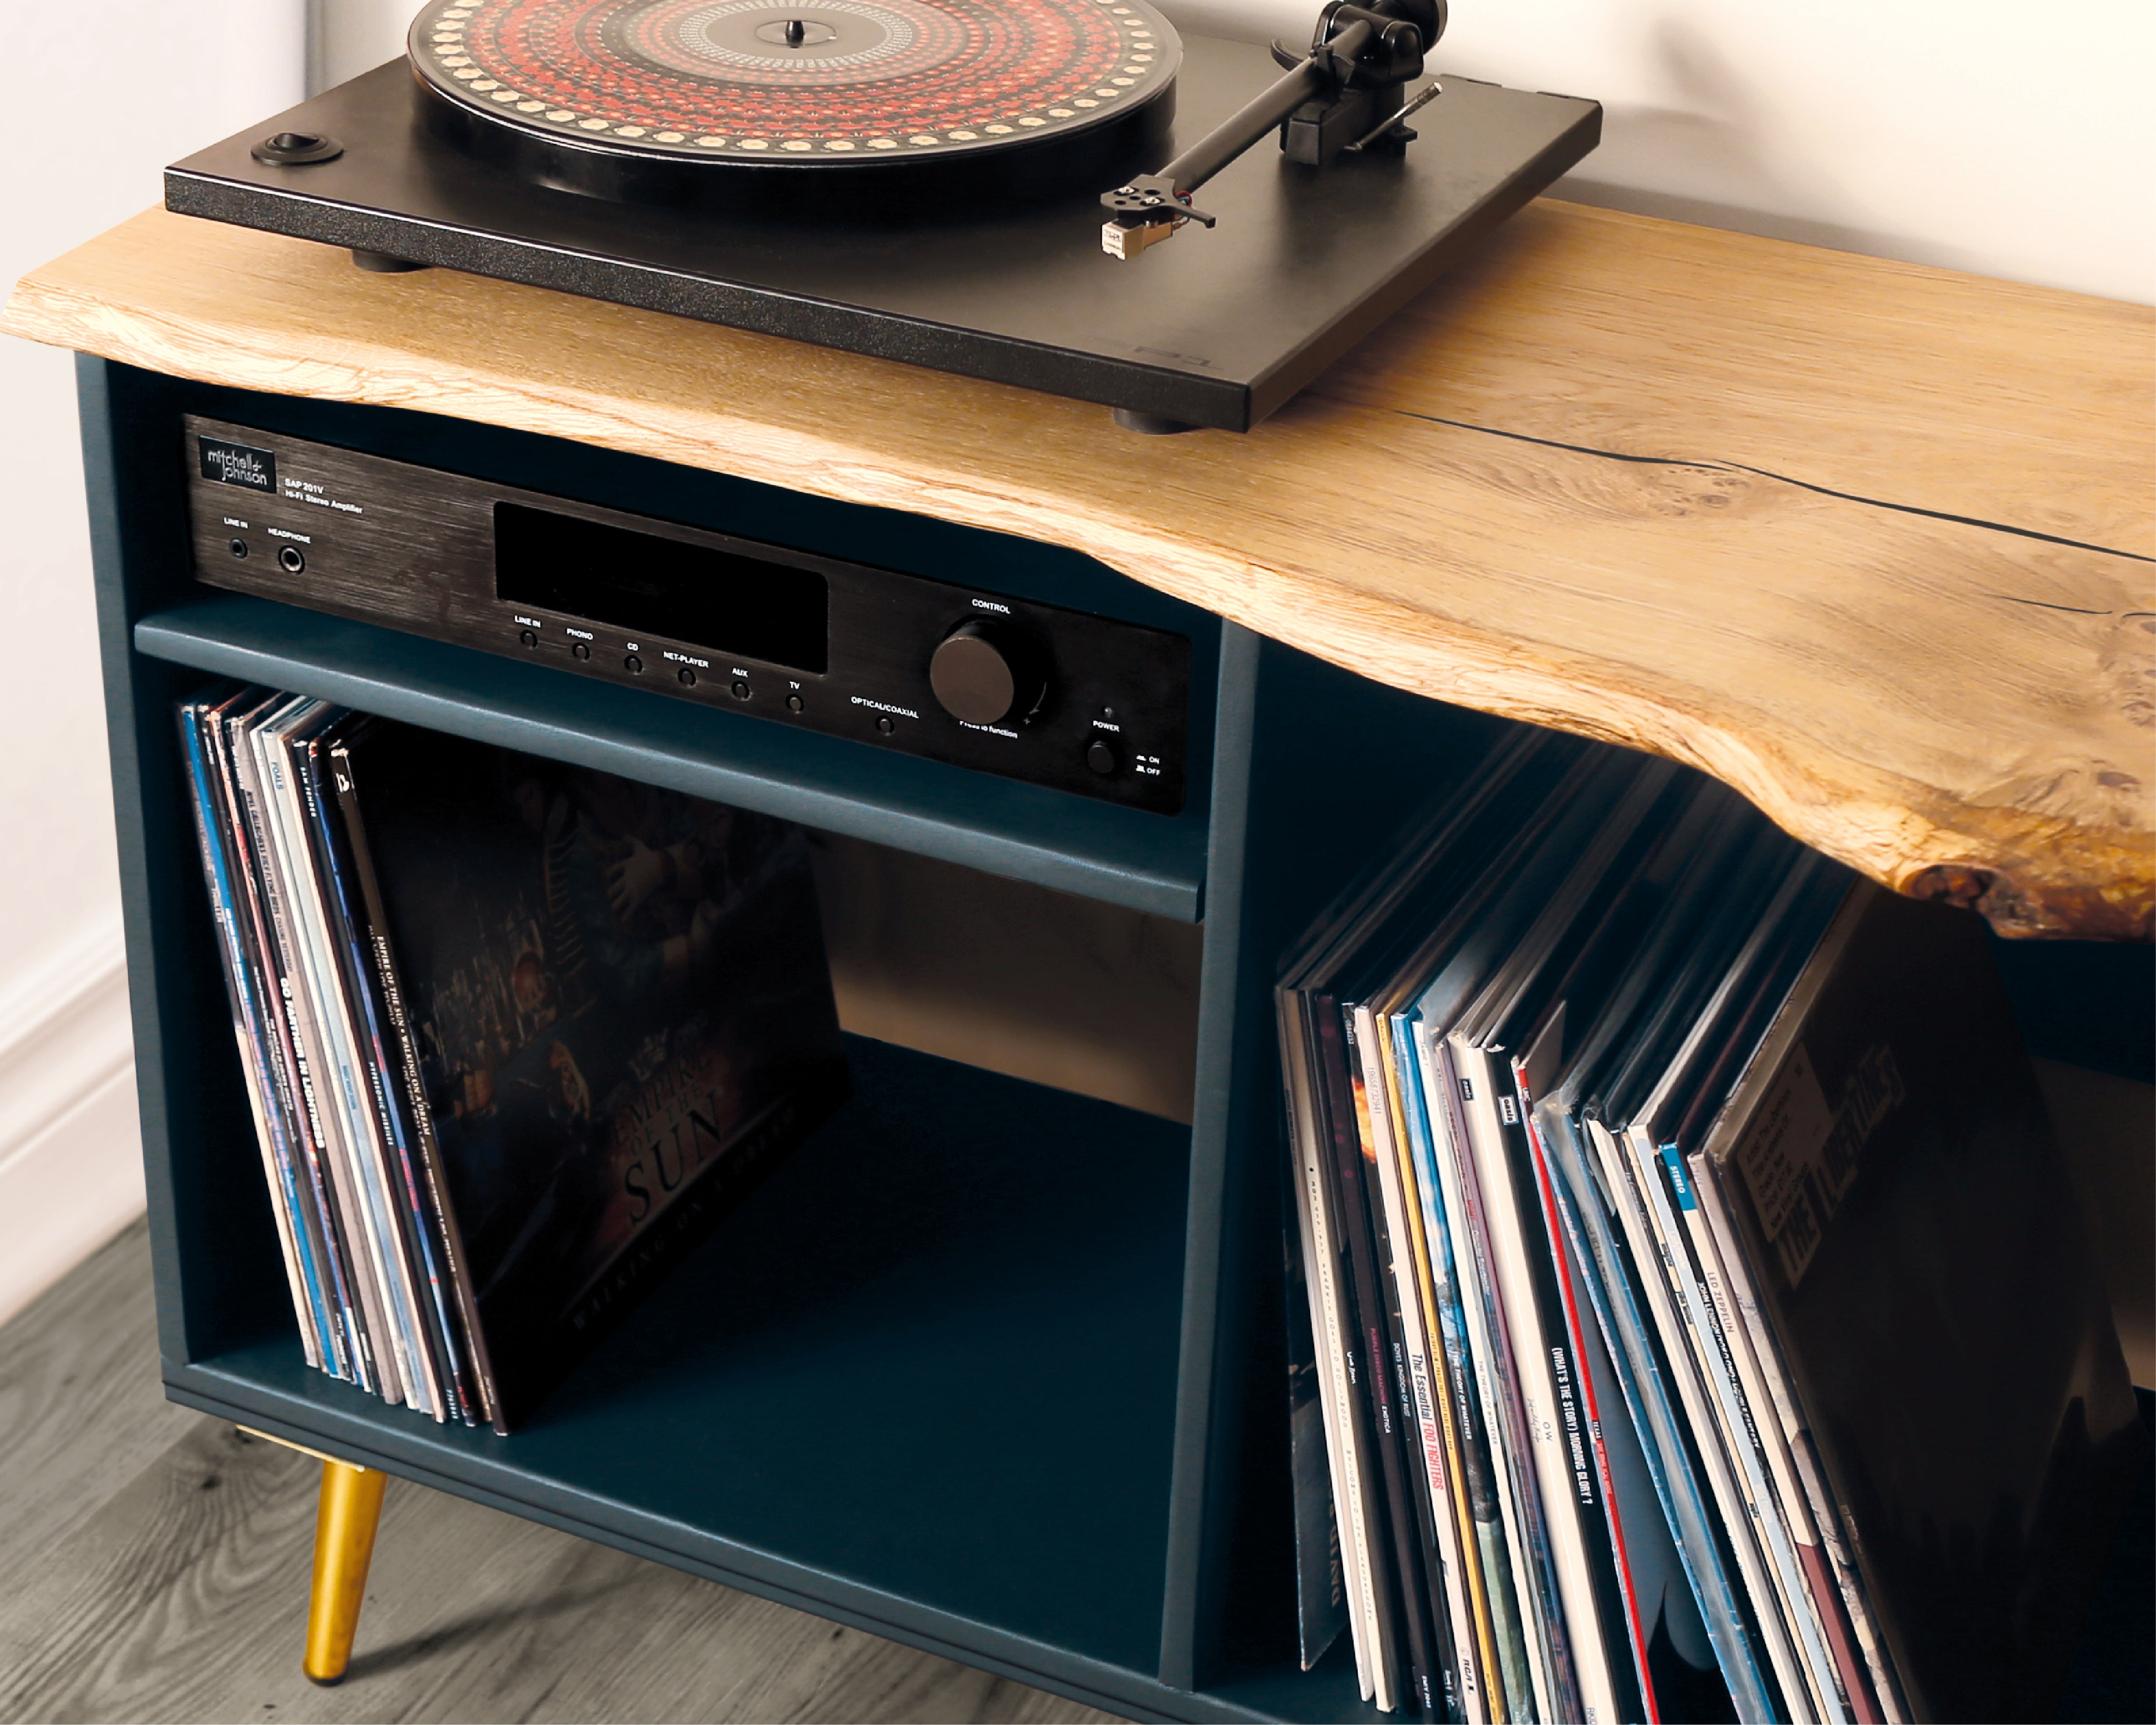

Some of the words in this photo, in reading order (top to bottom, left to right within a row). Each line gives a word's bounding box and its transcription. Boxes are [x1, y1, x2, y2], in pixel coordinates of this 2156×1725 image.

[208, 450, 253, 470] mitchell
[285, 478, 302, 488] SAP
[303, 482, 324, 494] 201V
[305, 494, 330, 506] Stereo
[331, 500, 363, 514] Amplifier
[224, 517, 239, 527] LINE
[267, 527, 311, 544] HEADPHONE
[972, 599, 1011, 614] CONTROL
[514, 615, 532, 626] LINE
[566, 627, 594, 640] PHONO
[626, 642, 639, 651] CD
[663, 651, 709, 669] NET-PLAYER
[732, 667, 748, 678] AUX
[790, 681, 800, 690] TV
[851, 696, 920, 719] OPTICAL/COAXIAL
[1093, 720, 1120, 733] POWER
[1149, 756, 1160, 765] ON
[1146, 767, 1161, 776] OFF
[1504, 1098, 1513, 1122] oasis
[624, 1092, 721, 1224] SUN
[1669, 1165, 1685, 1195] STEREO
[1708, 1272, 1719, 1288] LED
[1714, 1291, 1734, 1333] ZEPPELIN
[1412, 1353, 1423, 1372] The
[1552, 1347, 1568, 1383] (WHAT'S
[1415, 1374, 1433, 1421] Essential
[1560, 1384, 1572, 1400] THE
[1563, 1401, 1579, 1431] STORY)
[1424, 1423, 1436, 1443] FOO
[1569, 1432, 1586, 1470] MORNING
[1427, 1444, 1444, 1490] FIGHTERS
[1576, 1471, 1592, 1497] GLORY
